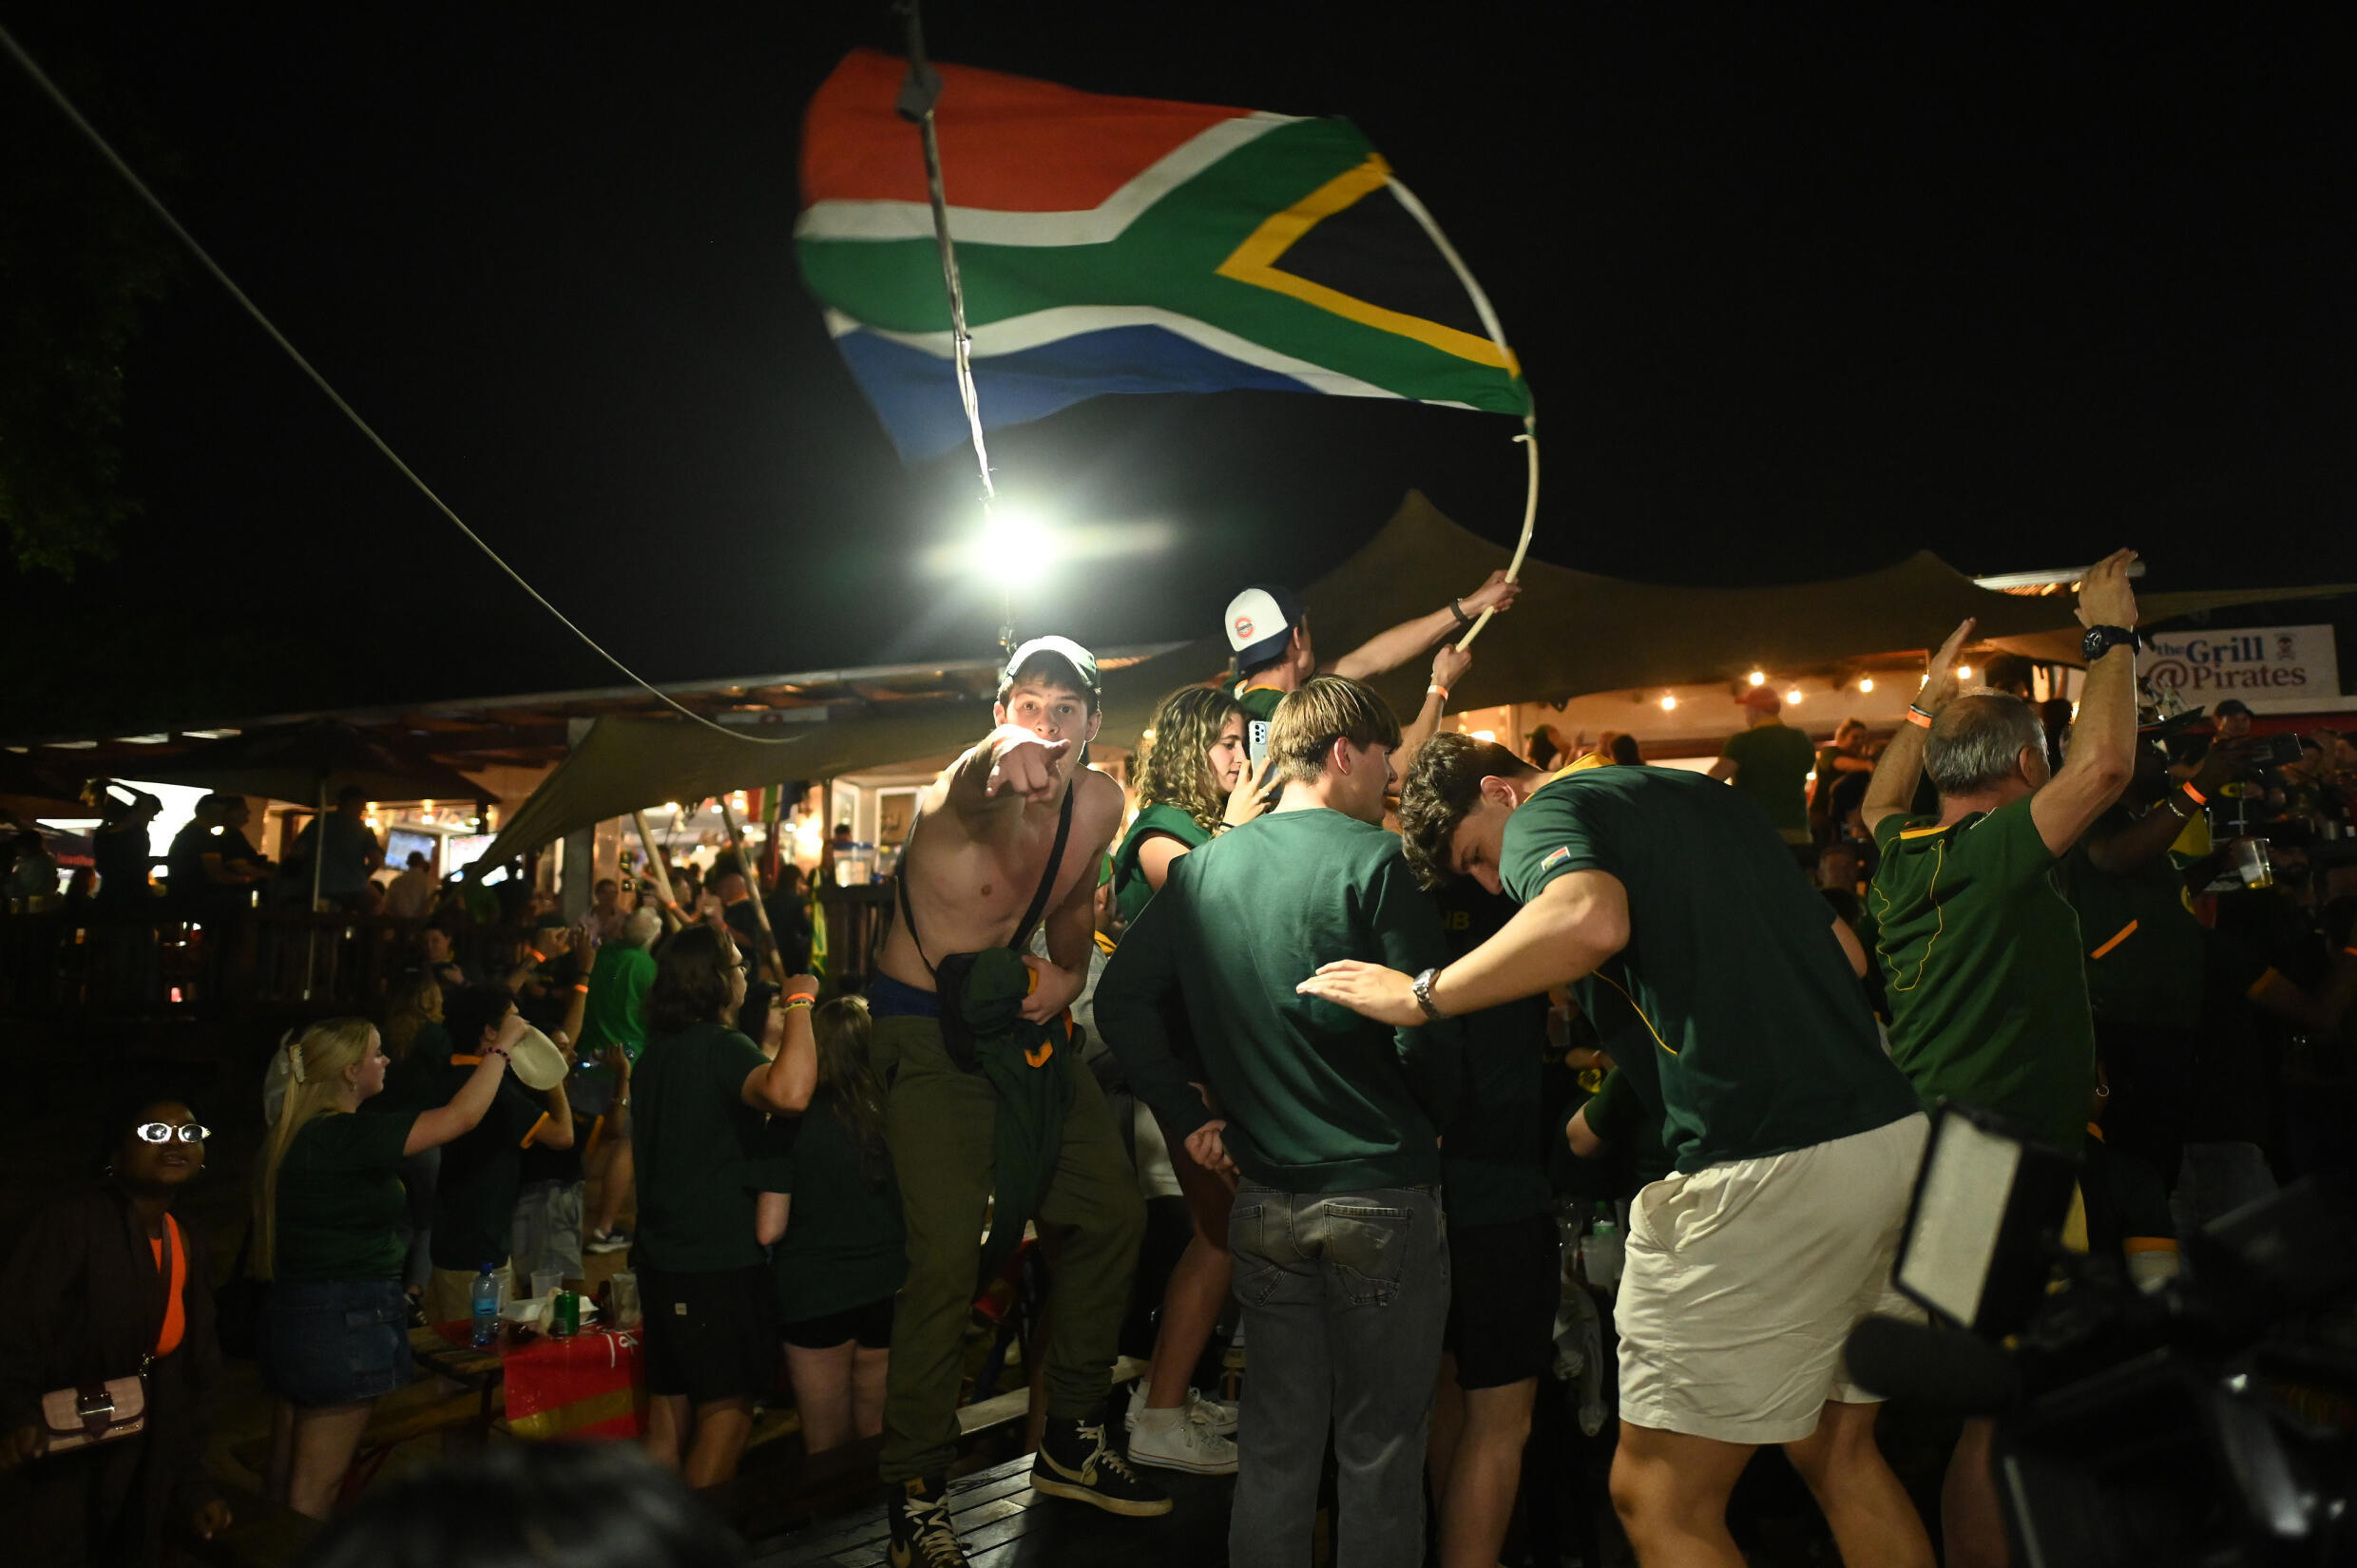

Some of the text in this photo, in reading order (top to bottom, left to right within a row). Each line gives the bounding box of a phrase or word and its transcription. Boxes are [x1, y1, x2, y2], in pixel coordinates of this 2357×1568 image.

[2156, 637, 2264, 664] the Grill
[2145, 660, 2307, 694] @Pirates
